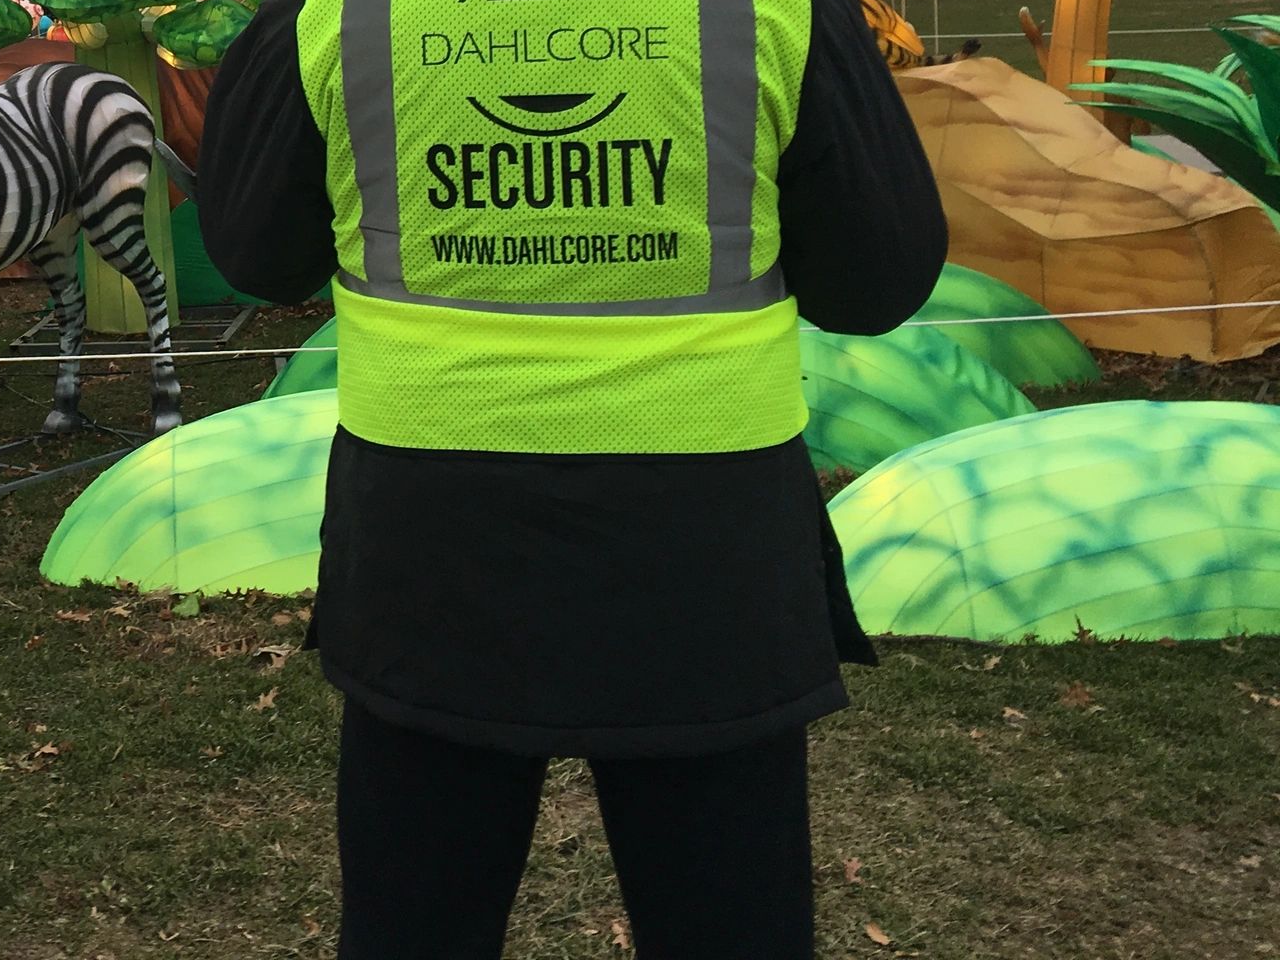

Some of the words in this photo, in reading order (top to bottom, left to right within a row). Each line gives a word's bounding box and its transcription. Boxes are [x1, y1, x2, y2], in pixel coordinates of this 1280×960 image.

[421, 26, 670, 66] DAHLCORE
[426, 138, 672, 210] SECURITY
[431, 232, 679, 265] WWW.DAHLCORE.COM
